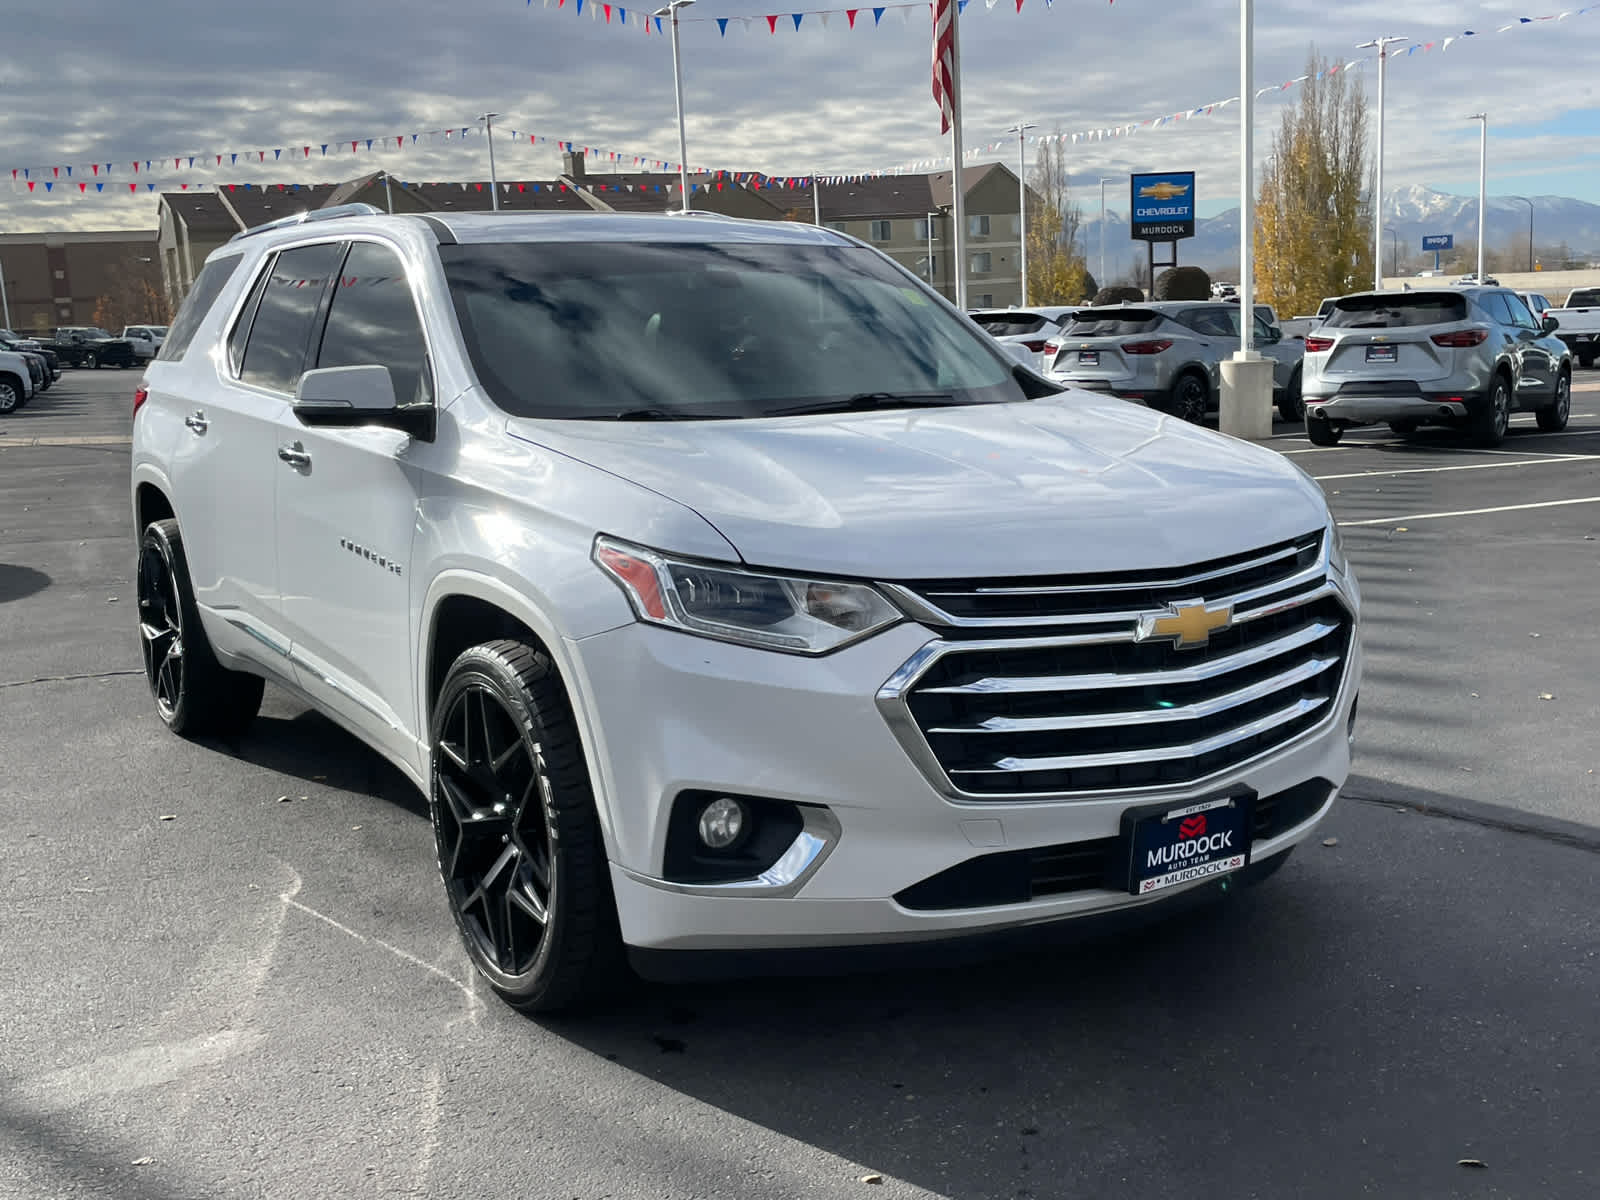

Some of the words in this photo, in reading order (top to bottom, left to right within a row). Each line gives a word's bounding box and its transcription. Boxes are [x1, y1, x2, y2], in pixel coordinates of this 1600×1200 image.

[1136, 206, 1189, 216] CHEVROLET
[1141, 225, 1185, 235] MURDOCK
[1147, 830, 1232, 868] MURDOCK
[1168, 861, 1188, 871] AUTO
[1190, 854, 1210, 864] TEAM
[1164, 862, 1221, 884] MURDOCK
